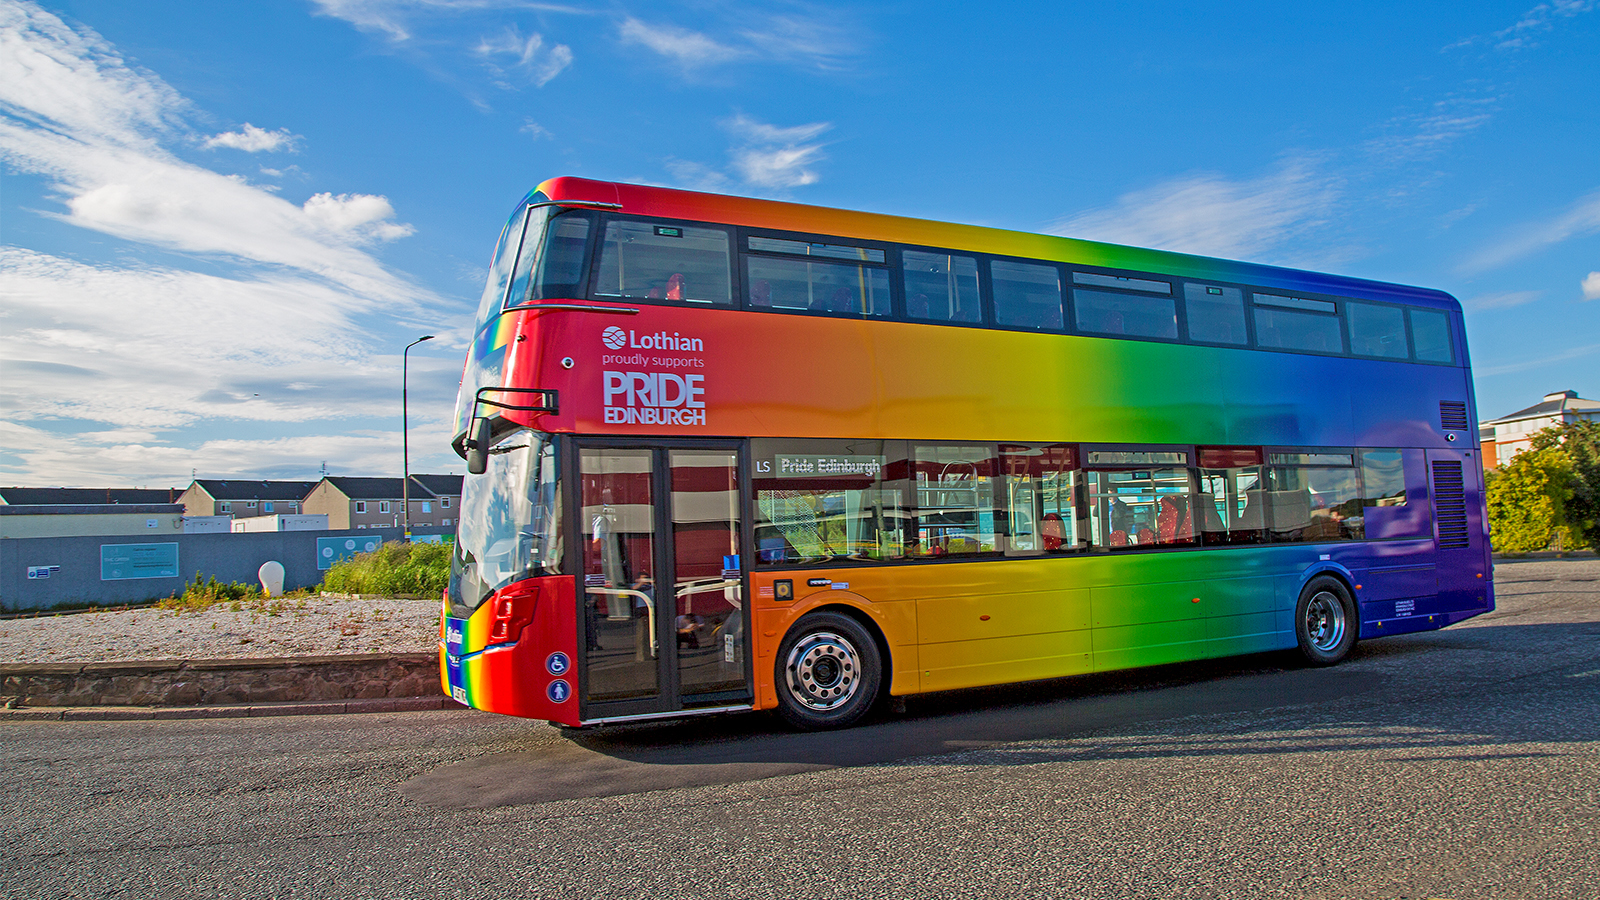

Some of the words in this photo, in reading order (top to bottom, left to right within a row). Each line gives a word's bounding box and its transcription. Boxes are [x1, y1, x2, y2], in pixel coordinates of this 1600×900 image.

[630, 330, 703, 351] Lothian
[602, 353, 649, 367] proudly
[652, 356, 705, 368] supports
[603, 370, 705, 408] PRIDE
[604, 406, 706, 425] EDINBURGH
[756, 461, 770, 473] LS
[781, 458, 814, 473] Pride
[817, 458, 880, 477] Edinburgh
